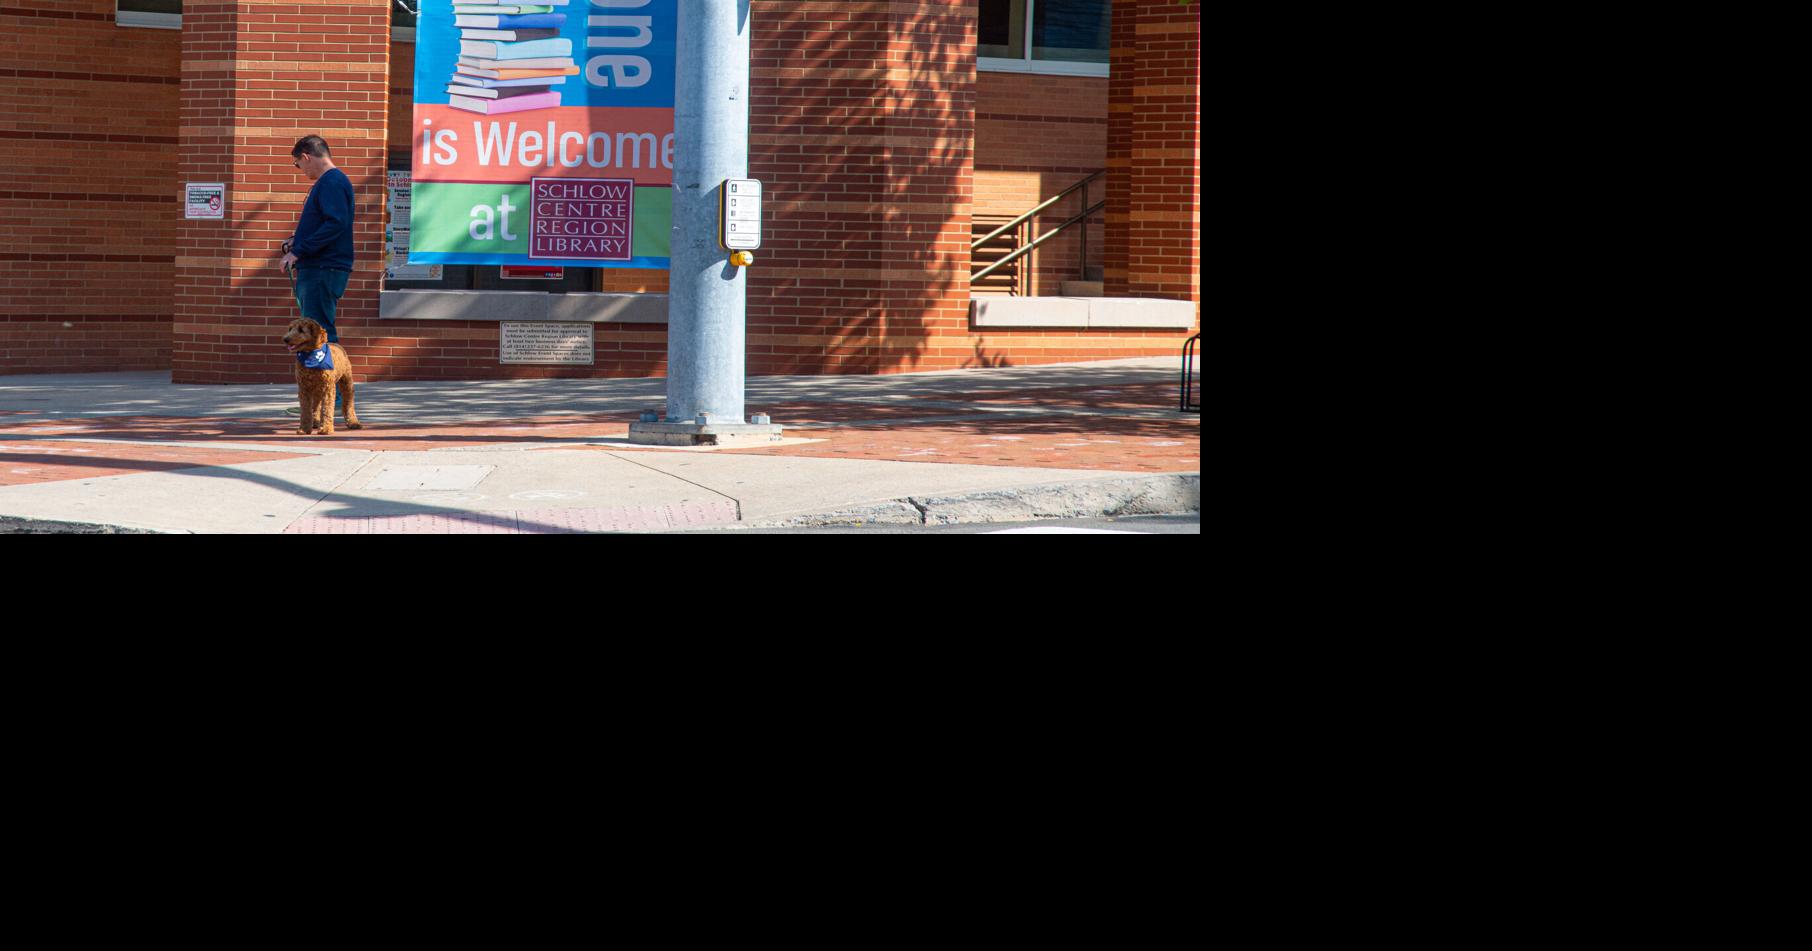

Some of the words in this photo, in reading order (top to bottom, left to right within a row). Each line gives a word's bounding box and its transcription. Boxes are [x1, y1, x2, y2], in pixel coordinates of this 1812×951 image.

[585, 0, 653, 88] ne
[422, 118, 458, 166] is
[537, 183, 628, 200] SCHLOW
[468, 194, 517, 241] at
[537, 201, 627, 218] CENTRE
[536, 219, 626, 236] REGION
[536, 237, 626, 253] LIBRARY
